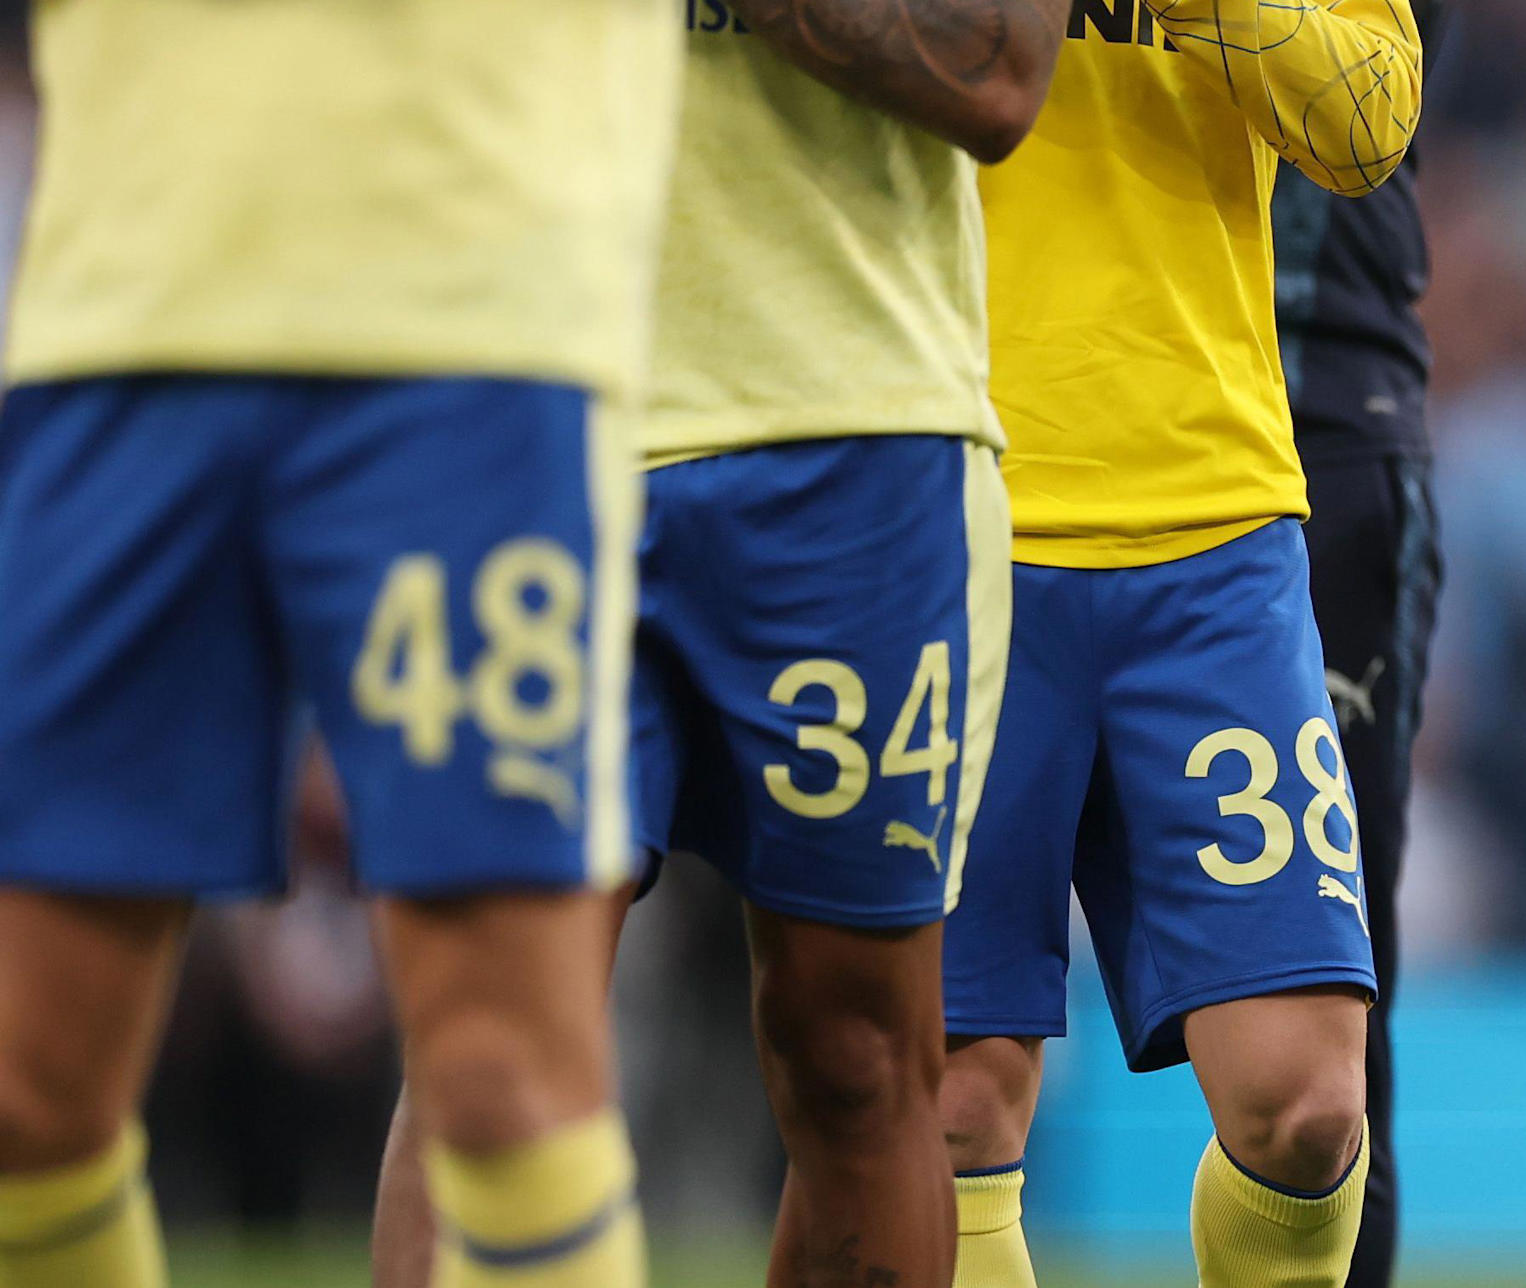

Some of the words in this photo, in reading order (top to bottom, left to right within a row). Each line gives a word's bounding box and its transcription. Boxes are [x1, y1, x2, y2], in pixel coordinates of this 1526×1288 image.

[350, 537, 588, 766] 48
[763, 641, 958, 820] 34
[1184, 716, 1357, 886] 38
